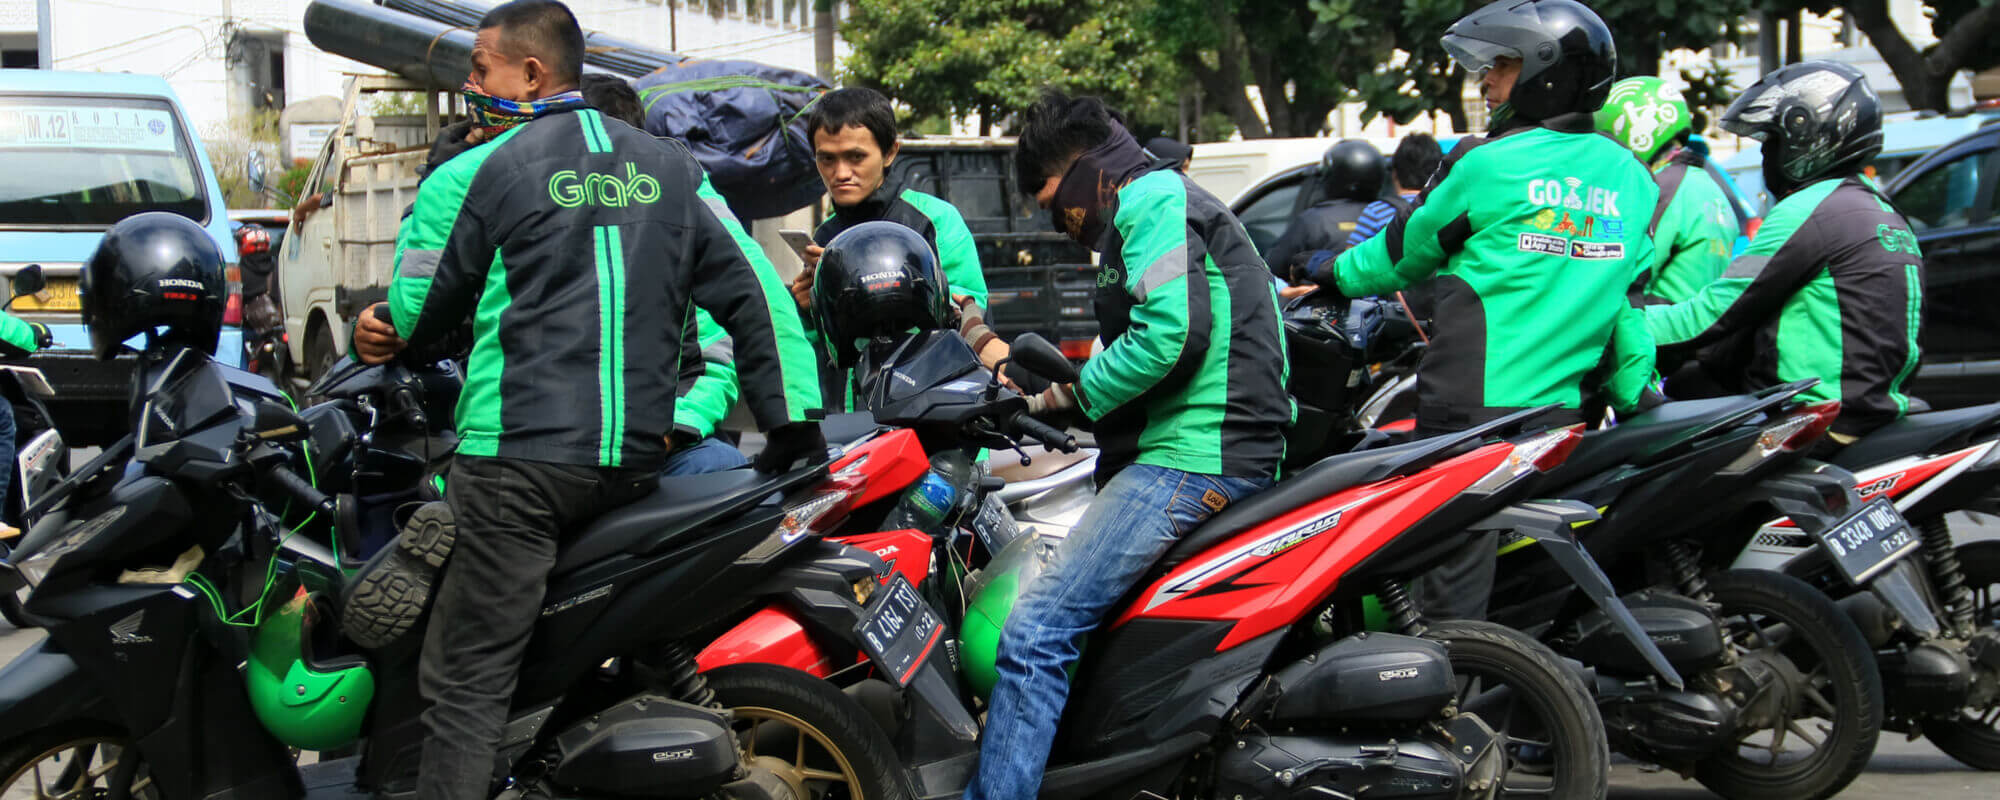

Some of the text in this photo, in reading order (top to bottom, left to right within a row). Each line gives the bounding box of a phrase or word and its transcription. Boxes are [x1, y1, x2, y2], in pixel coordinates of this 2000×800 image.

[548, 161, 661, 208] Grab
[1528, 179, 1562, 207] GO
[159, 279, 204, 291] HONDA
[861, 271, 906, 284] HONDA
[1831, 538, 1847, 557] B
[1841, 520, 1874, 550] 3348
[867, 631, 884, 654] B
[877, 604, 905, 639] 4164
[894, 583, 918, 614] TST
